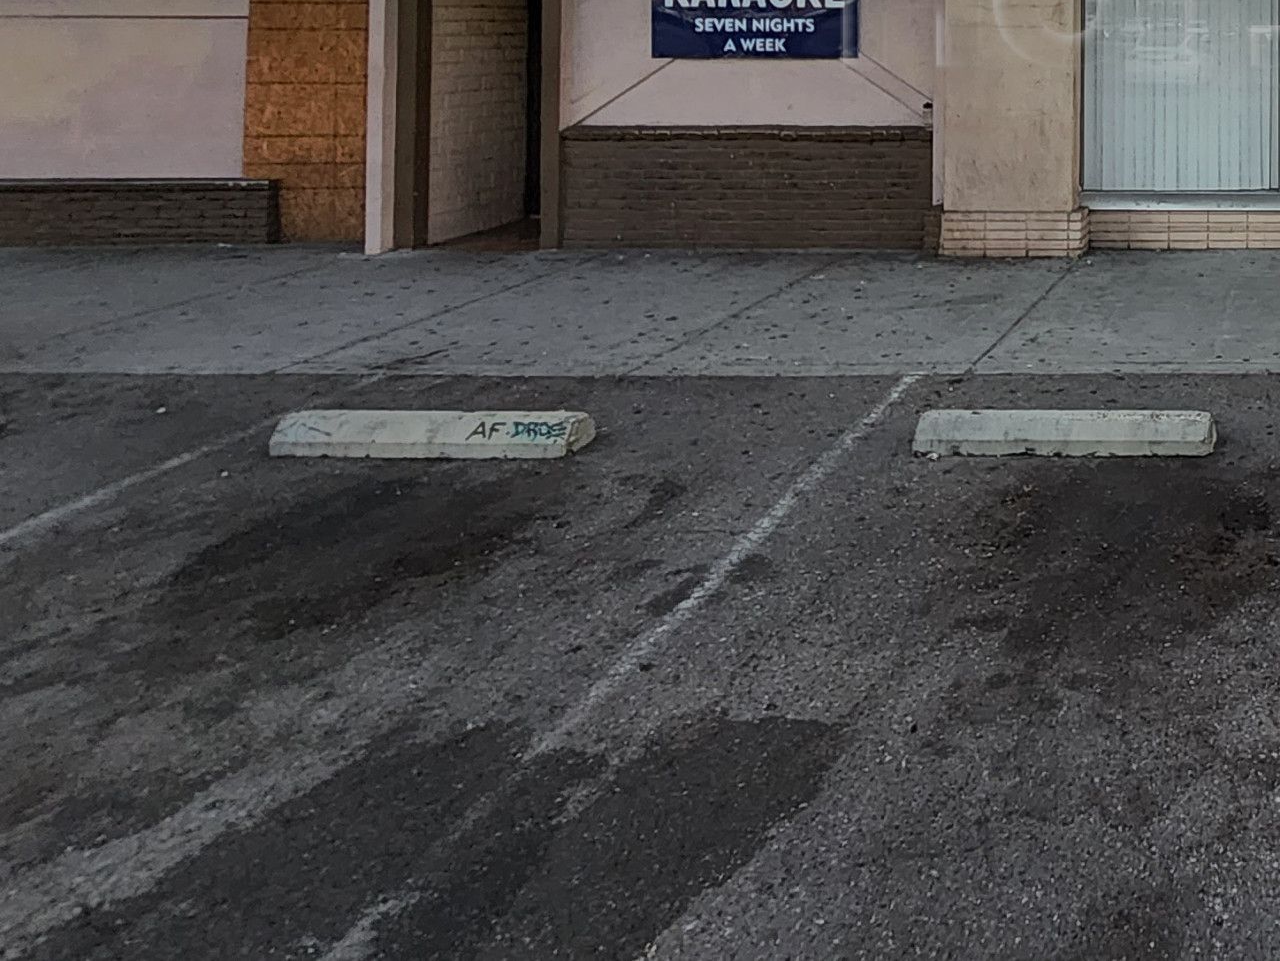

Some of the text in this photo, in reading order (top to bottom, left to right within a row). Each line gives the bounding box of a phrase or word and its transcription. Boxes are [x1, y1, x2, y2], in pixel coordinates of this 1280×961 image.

[694, 17, 815, 33] SEVEN NIGHTS
[723, 38, 786, 52] A WEEK
